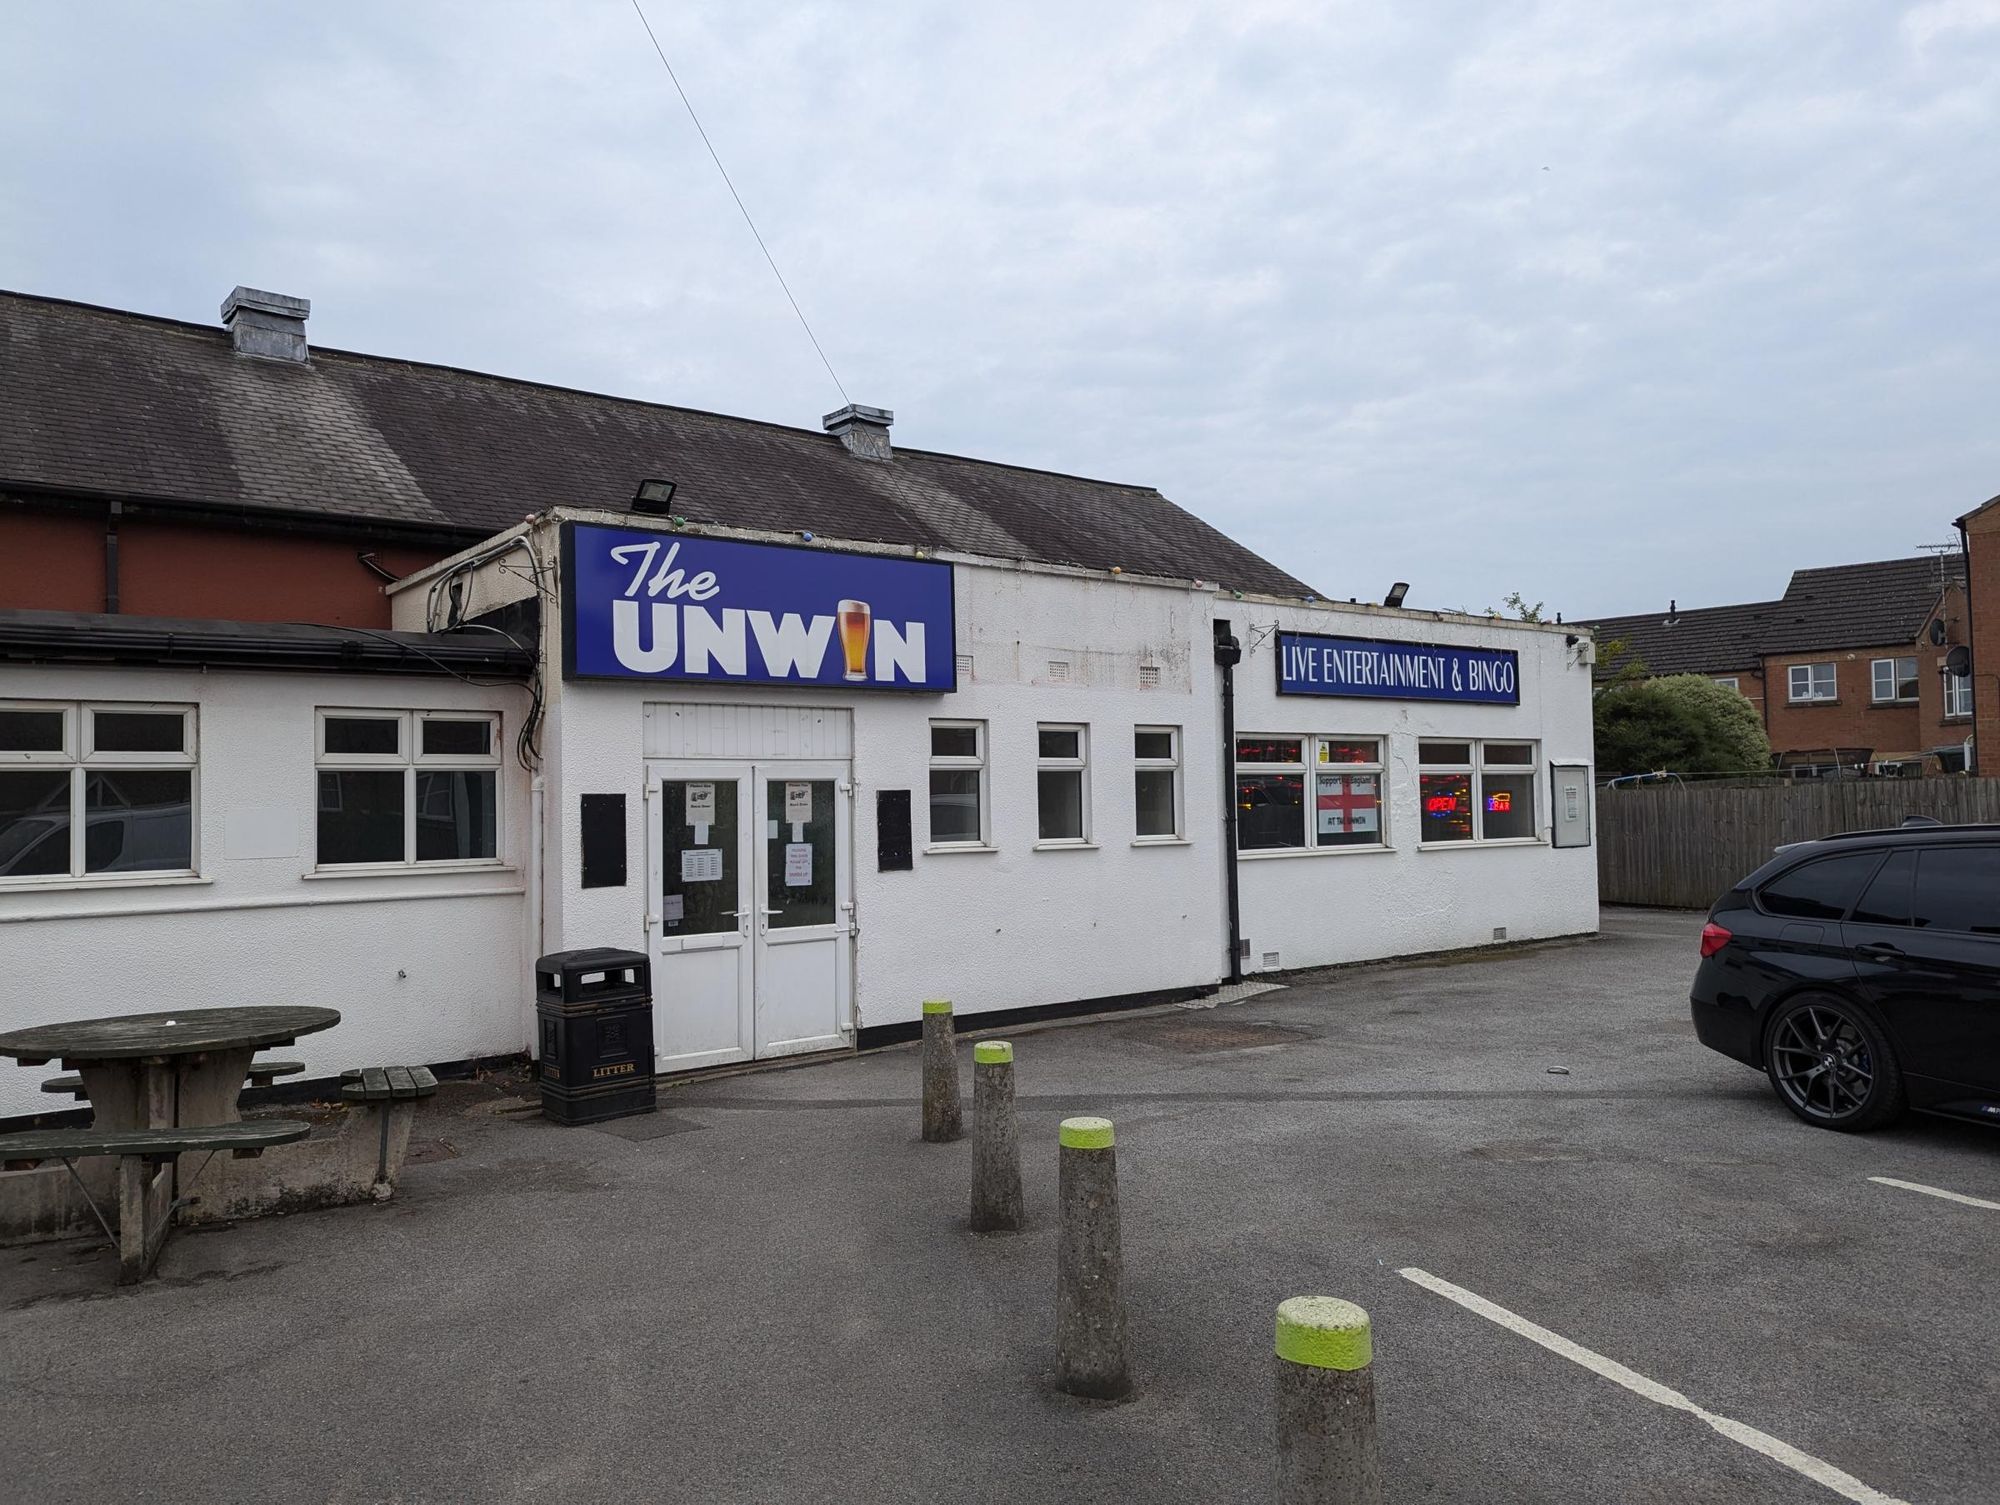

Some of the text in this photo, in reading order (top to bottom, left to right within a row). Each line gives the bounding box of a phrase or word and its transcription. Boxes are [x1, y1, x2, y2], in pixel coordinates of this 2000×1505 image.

[611, 541, 720, 600] The
[1282, 645, 1514, 693] LIVE ENTERTAINMENT & BINGO
[1428, 797, 1456, 811] OPEN
[1494, 801, 1510, 810] BAR
[593, 1063, 635, 1077] LITTER
